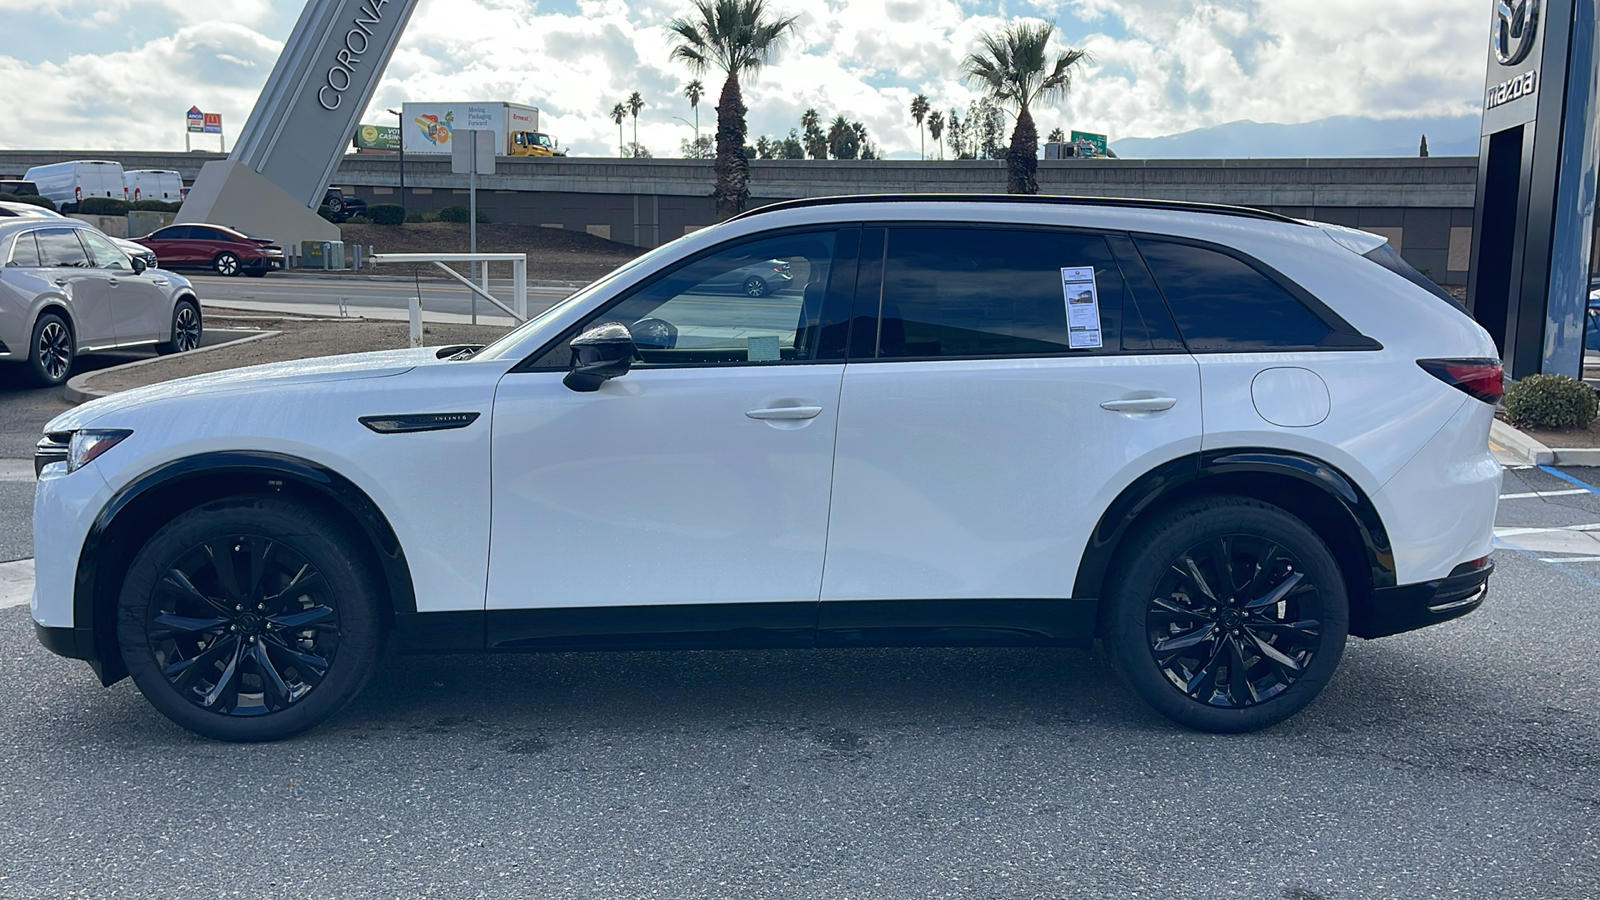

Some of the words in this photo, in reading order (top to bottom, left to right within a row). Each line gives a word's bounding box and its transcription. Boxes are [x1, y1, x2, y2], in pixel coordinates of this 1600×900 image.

[318, 0, 389, 111] CORONA
[1487, 69, 1537, 110] mazda
[513, 113, 529, 122] Ernest
